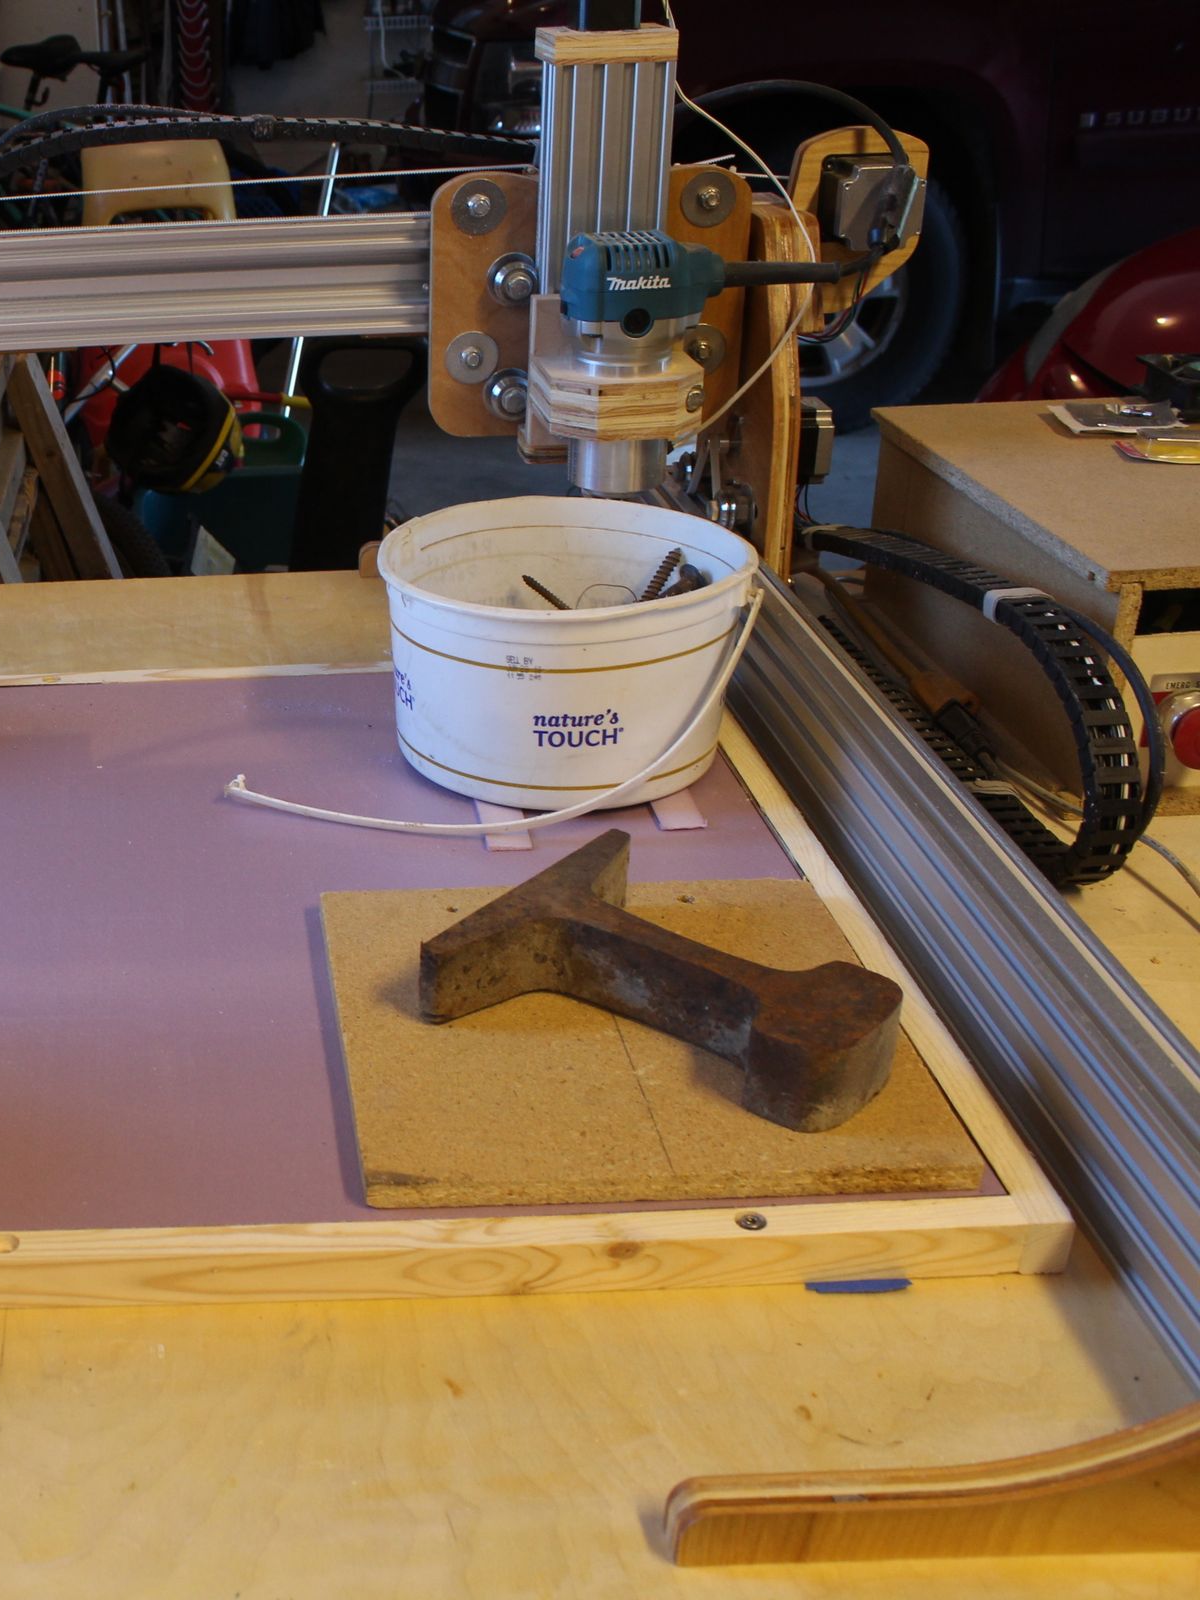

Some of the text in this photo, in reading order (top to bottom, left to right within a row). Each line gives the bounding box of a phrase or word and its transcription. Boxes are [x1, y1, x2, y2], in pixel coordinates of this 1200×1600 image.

[1103, 106, 1200, 127] SUBU
[606, 275, 671, 291] Makita
[533, 708, 619, 728] nature's
[533, 728, 618, 748] TOUCH
